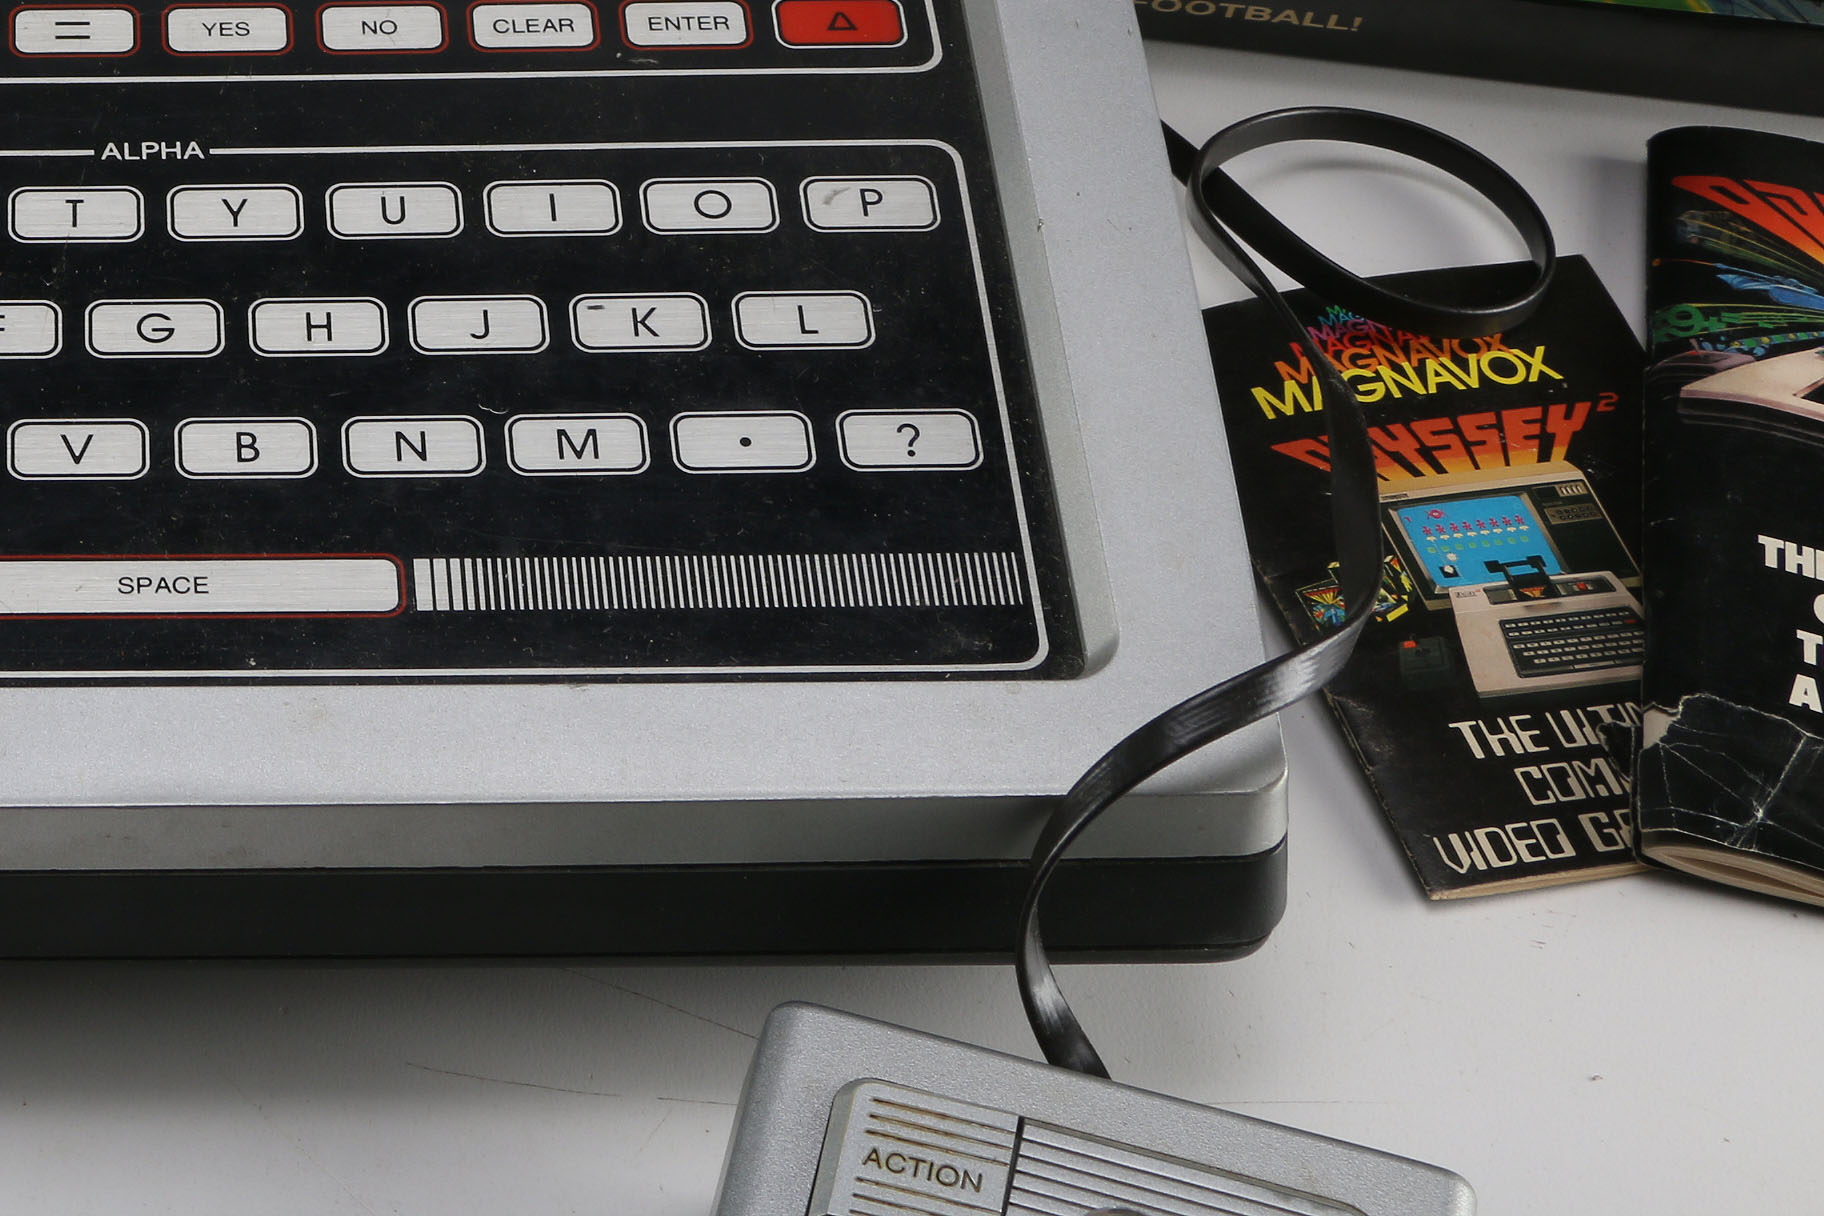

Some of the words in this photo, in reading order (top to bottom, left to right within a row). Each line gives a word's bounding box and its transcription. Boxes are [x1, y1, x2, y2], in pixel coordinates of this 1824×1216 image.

[202, 21, 250, 37] YES
[361, 19, 398, 35] NO
[492, 18, 575, 34] CLEAR
[648, 15, 730, 31] ENTER
[101, 141, 205, 161] ALPHA
[65, 199, 85, 228] T
[221, 198, 248, 228] Y
[380, 195, 406, 225] U
[859, 188, 883, 217] P
[136, 312, 175, 344] G
[305, 311, 333, 342] H
[470, 309, 490, 340] J
[631, 307, 660, 337] K
[797, 304, 819, 335] L
[60, 434, 94, 465] V
[235, 431, 260, 463] B
[395, 430, 428, 462] N
[556, 428, 600, 460] M
[896, 423, 920, 457] ?
[117, 576, 209, 595] SPACE
[1448, 715, 1550, 759] THE
[1513, 757, 1631, 806] COM
[1433, 818, 1576, 874] VIDEO
[862, 1147, 984, 1194] ACTION
